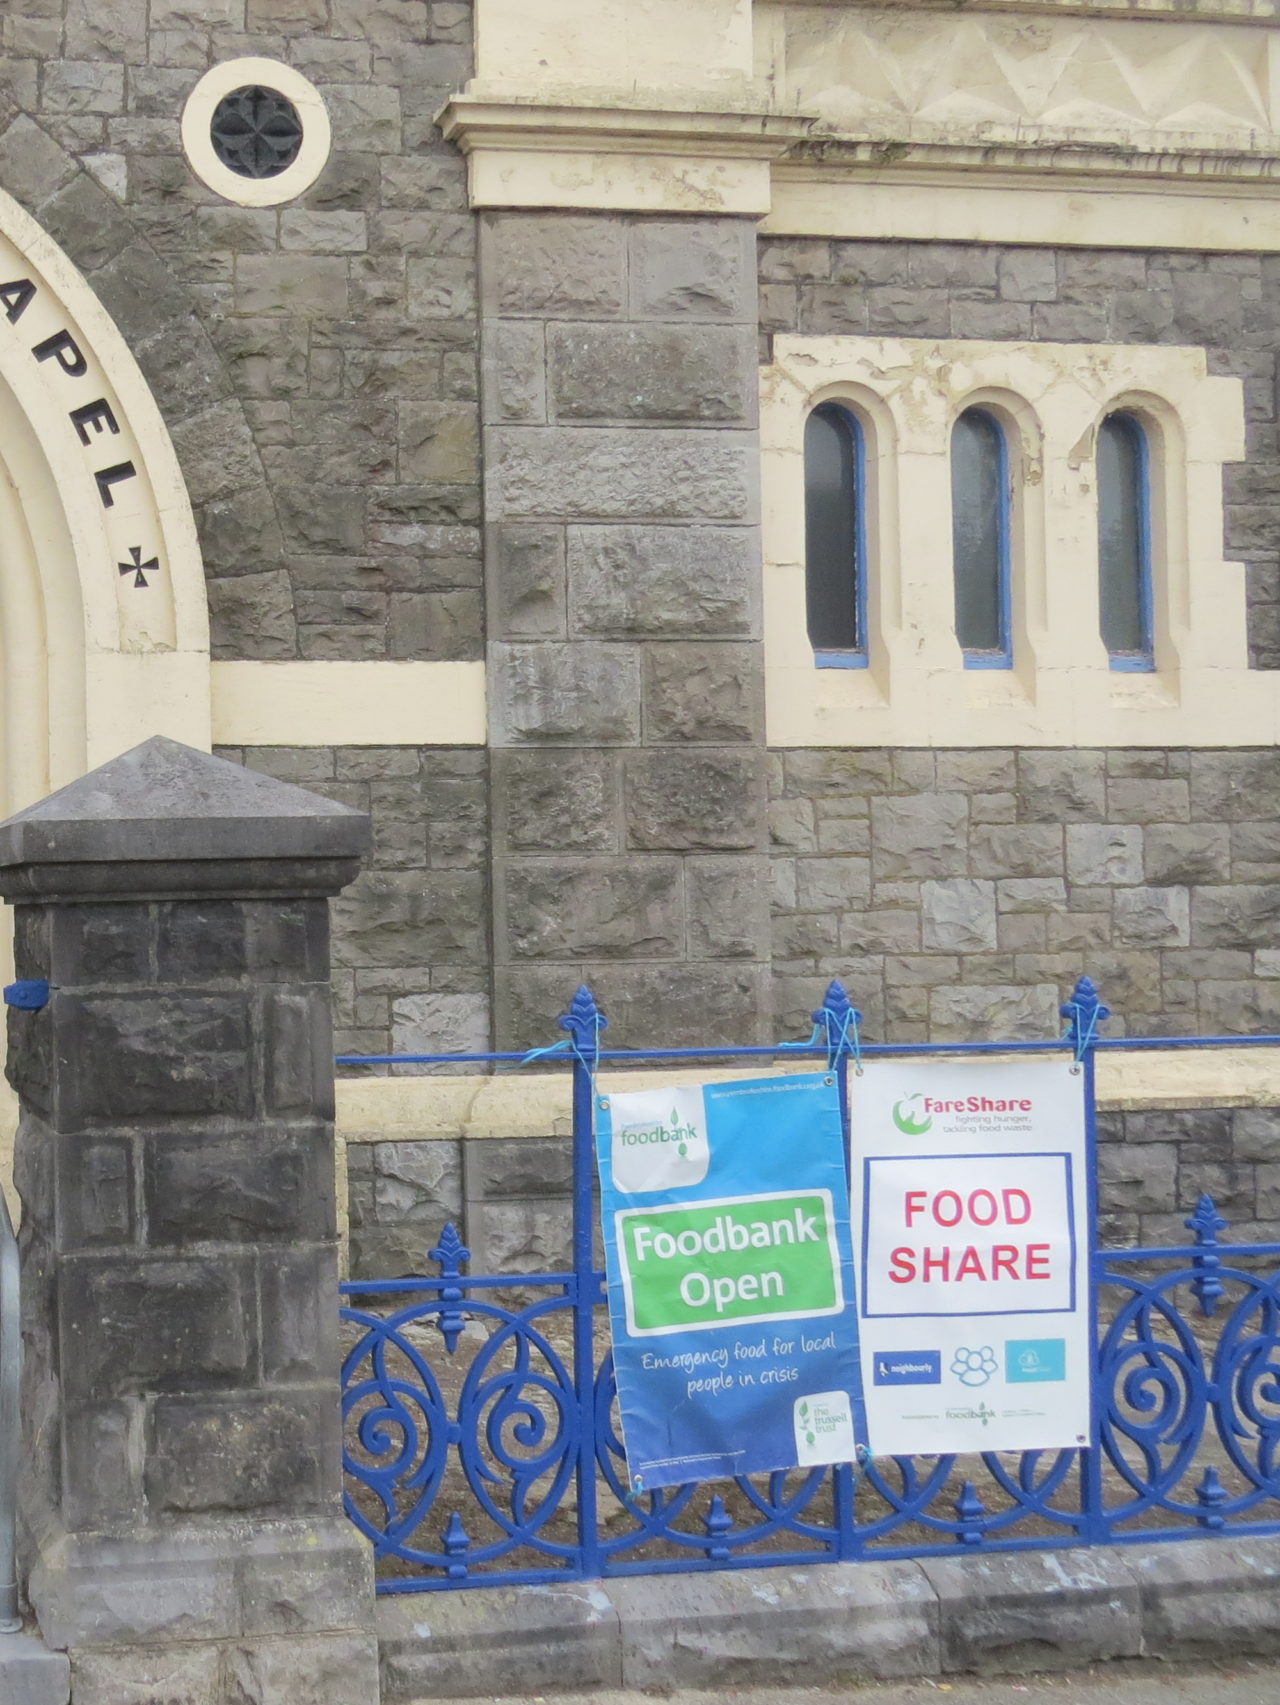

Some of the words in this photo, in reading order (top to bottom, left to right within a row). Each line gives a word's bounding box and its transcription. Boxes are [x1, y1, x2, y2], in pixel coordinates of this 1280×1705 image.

[621, 1122, 697, 1146] foodbank
[943, 1125, 977, 1134] tackling
[979, 1124, 1000, 1132] food
[1003, 1124, 1033, 1132] waste
[956, 1115, 991, 1125] fighting
[904, 1189, 1032, 1228] FOOD
[633, 1207, 820, 1261] Foodbank
[888, 1243, 1052, 1284] SHARE
[679, 1270, 785, 1313] Open
[640, 1347, 729, 1374] Emergency
[733, 1339, 768, 1361] food
[772, 1337, 796, 1355] for
[801, 1331, 837, 1351] local
[891, 1363, 932, 1374] neighbourly
[686, 1372, 734, 1399] people
[739, 1371, 756, 1387] in
[760, 1367, 800, 1385] crisis
[945, 1407, 996, 1419] foodbank
[815, 1422, 837, 1434] trust
